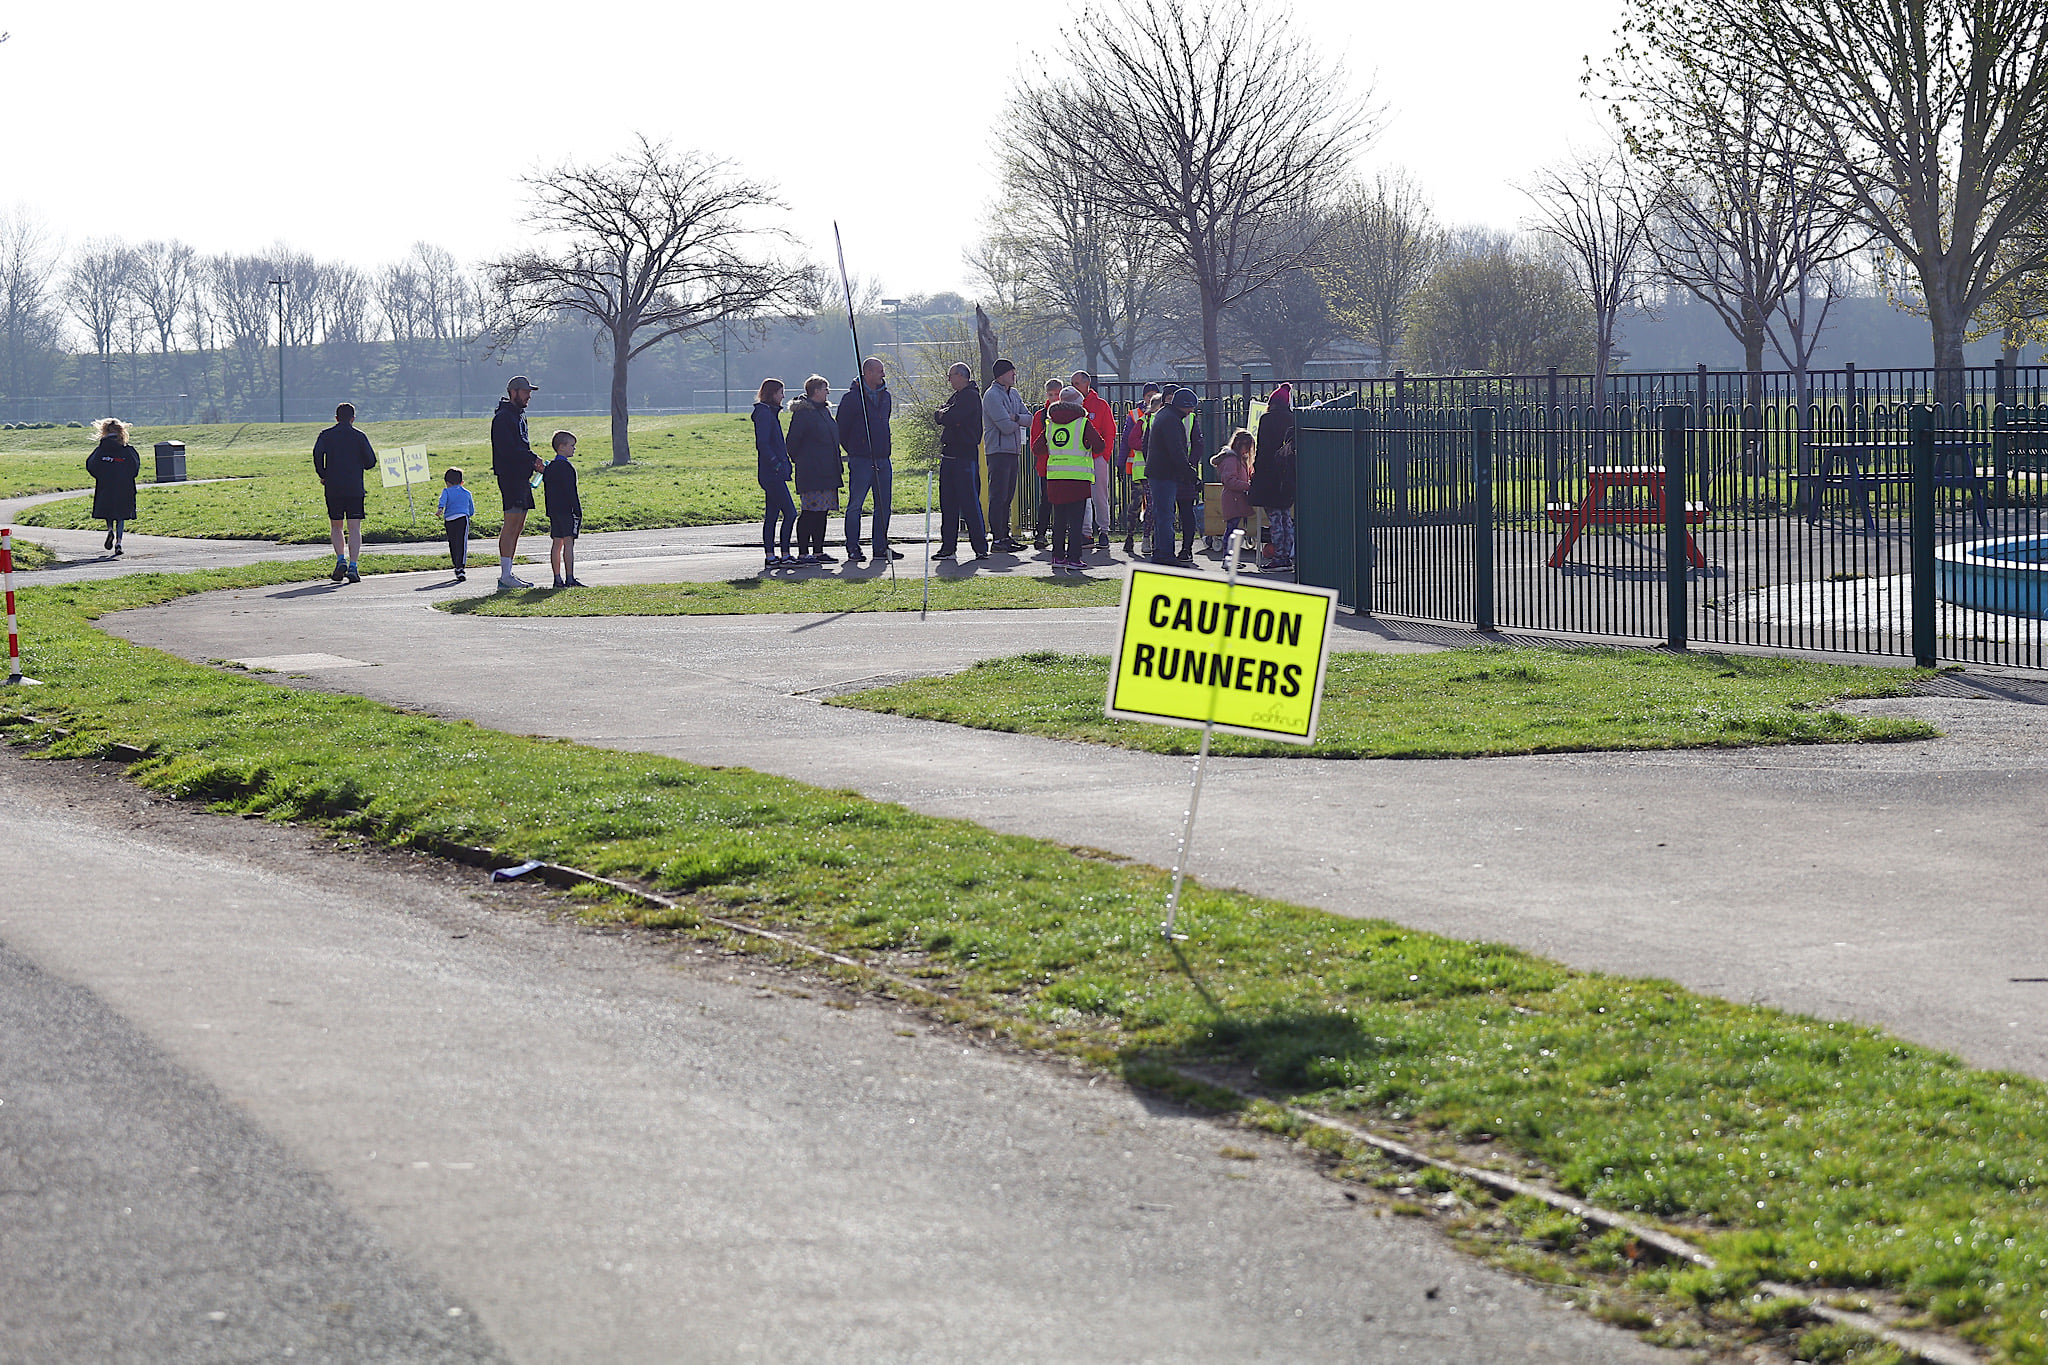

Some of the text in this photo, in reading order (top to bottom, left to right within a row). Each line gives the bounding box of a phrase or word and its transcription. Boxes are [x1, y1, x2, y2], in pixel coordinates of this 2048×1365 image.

[1149, 594, 1302, 646] CAUTION
[1133, 643, 1302, 697] RUNNERS
[1251, 703, 1305, 728] parkrun
